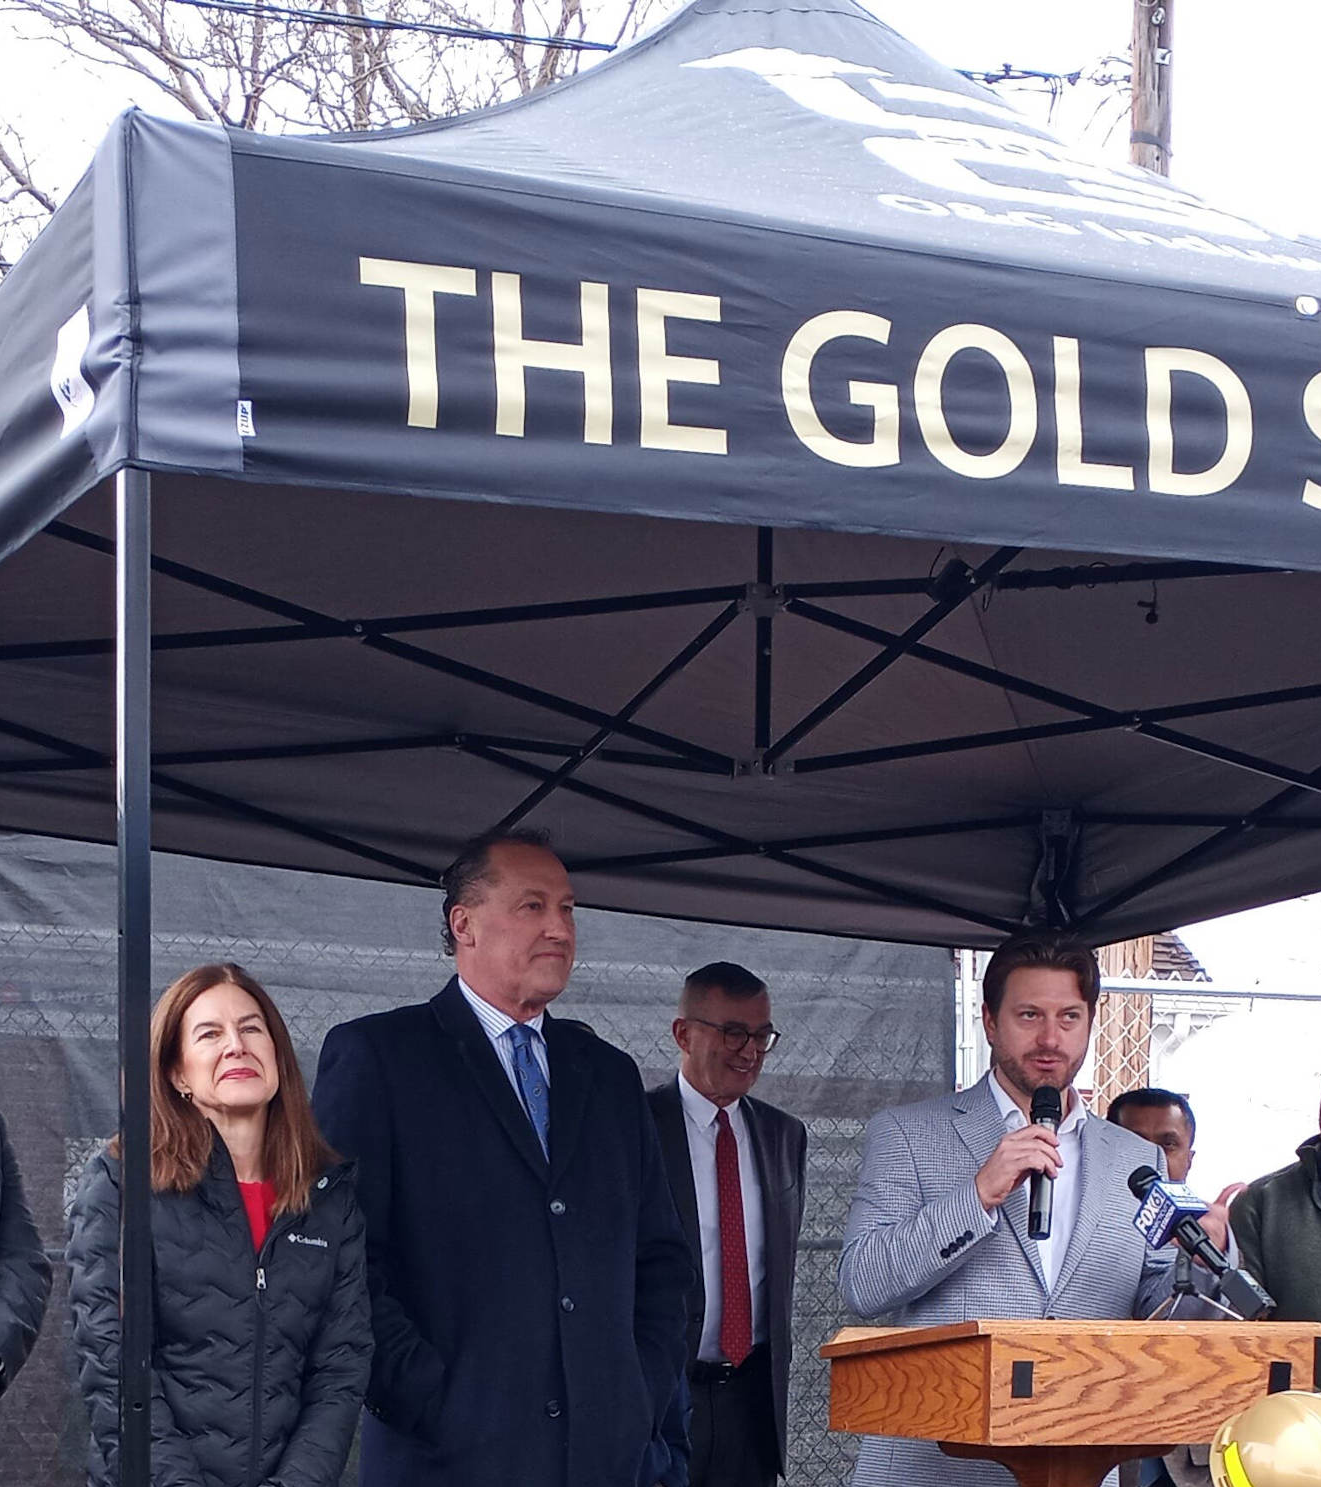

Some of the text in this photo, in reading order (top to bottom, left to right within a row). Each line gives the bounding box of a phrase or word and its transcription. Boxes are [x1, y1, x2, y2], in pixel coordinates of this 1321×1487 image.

[358, 255, 729, 456] THE
[779, 309, 1255, 498] GOLD
[1134, 1185, 1166, 1236] FOX61
